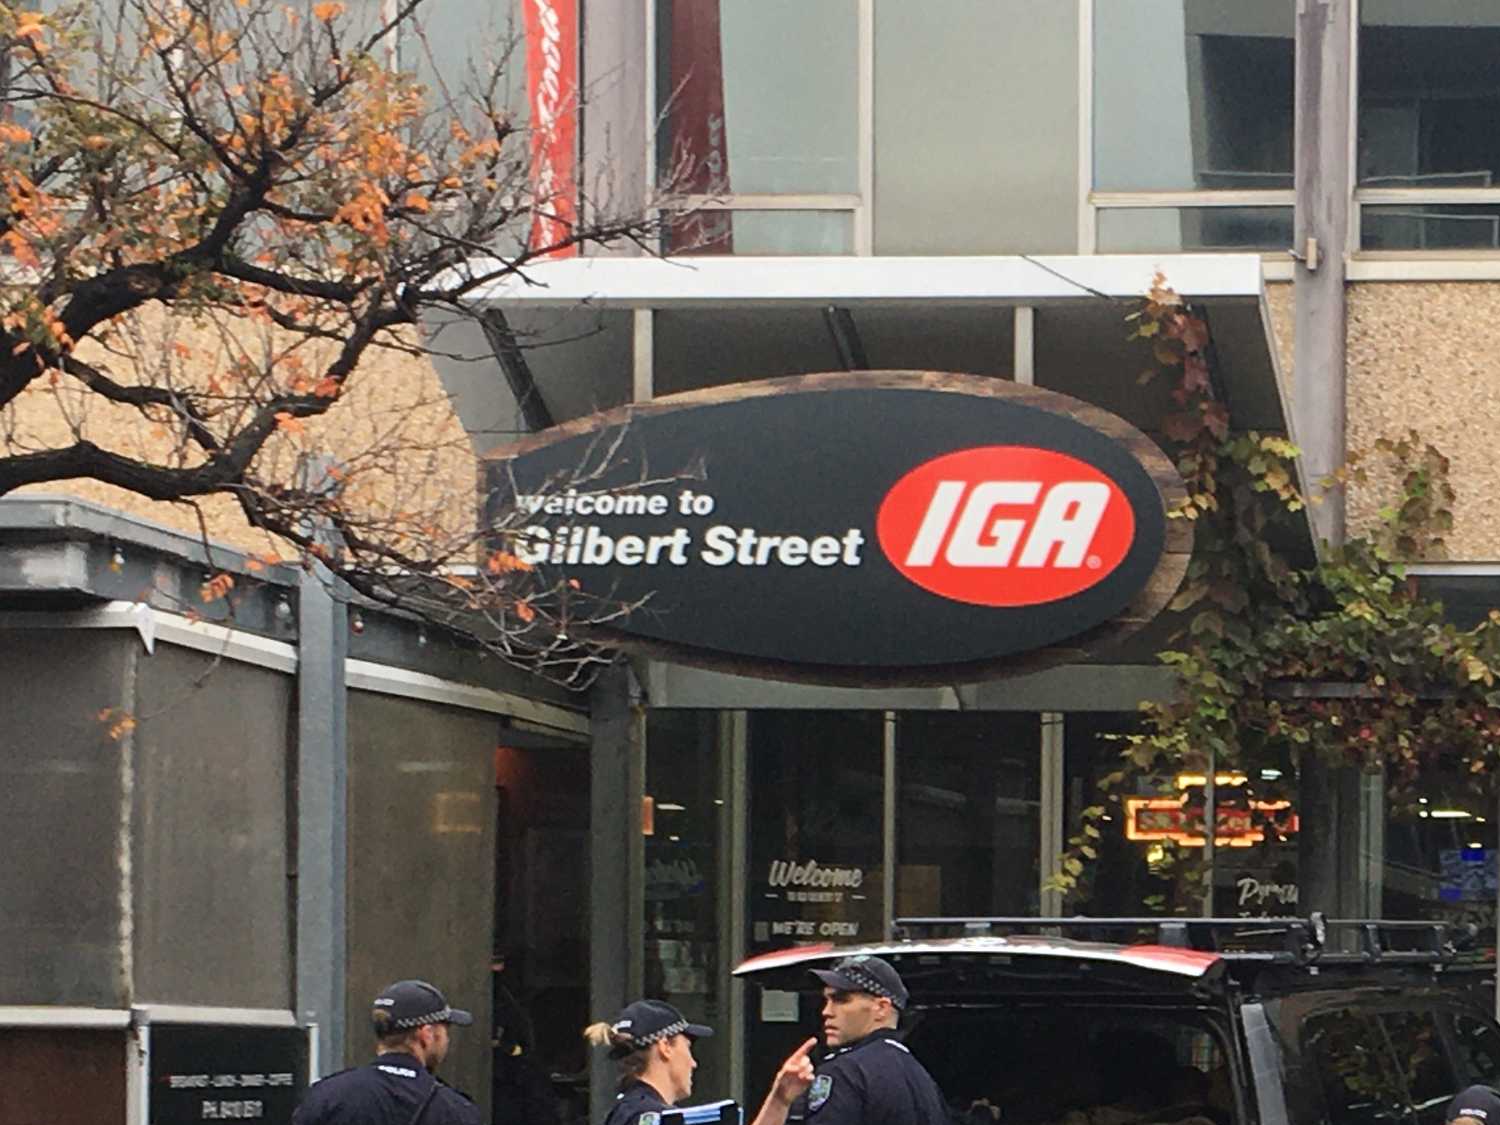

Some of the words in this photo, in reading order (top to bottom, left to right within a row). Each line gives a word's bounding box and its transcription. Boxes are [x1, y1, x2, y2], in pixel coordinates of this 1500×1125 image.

[680, 490, 714, 515] to
[906, 481, 1111, 568] IGA
[515, 525, 691, 566] Gilbert
[701, 525, 865, 567] Street
[768, 860, 863, 888] Welcome
